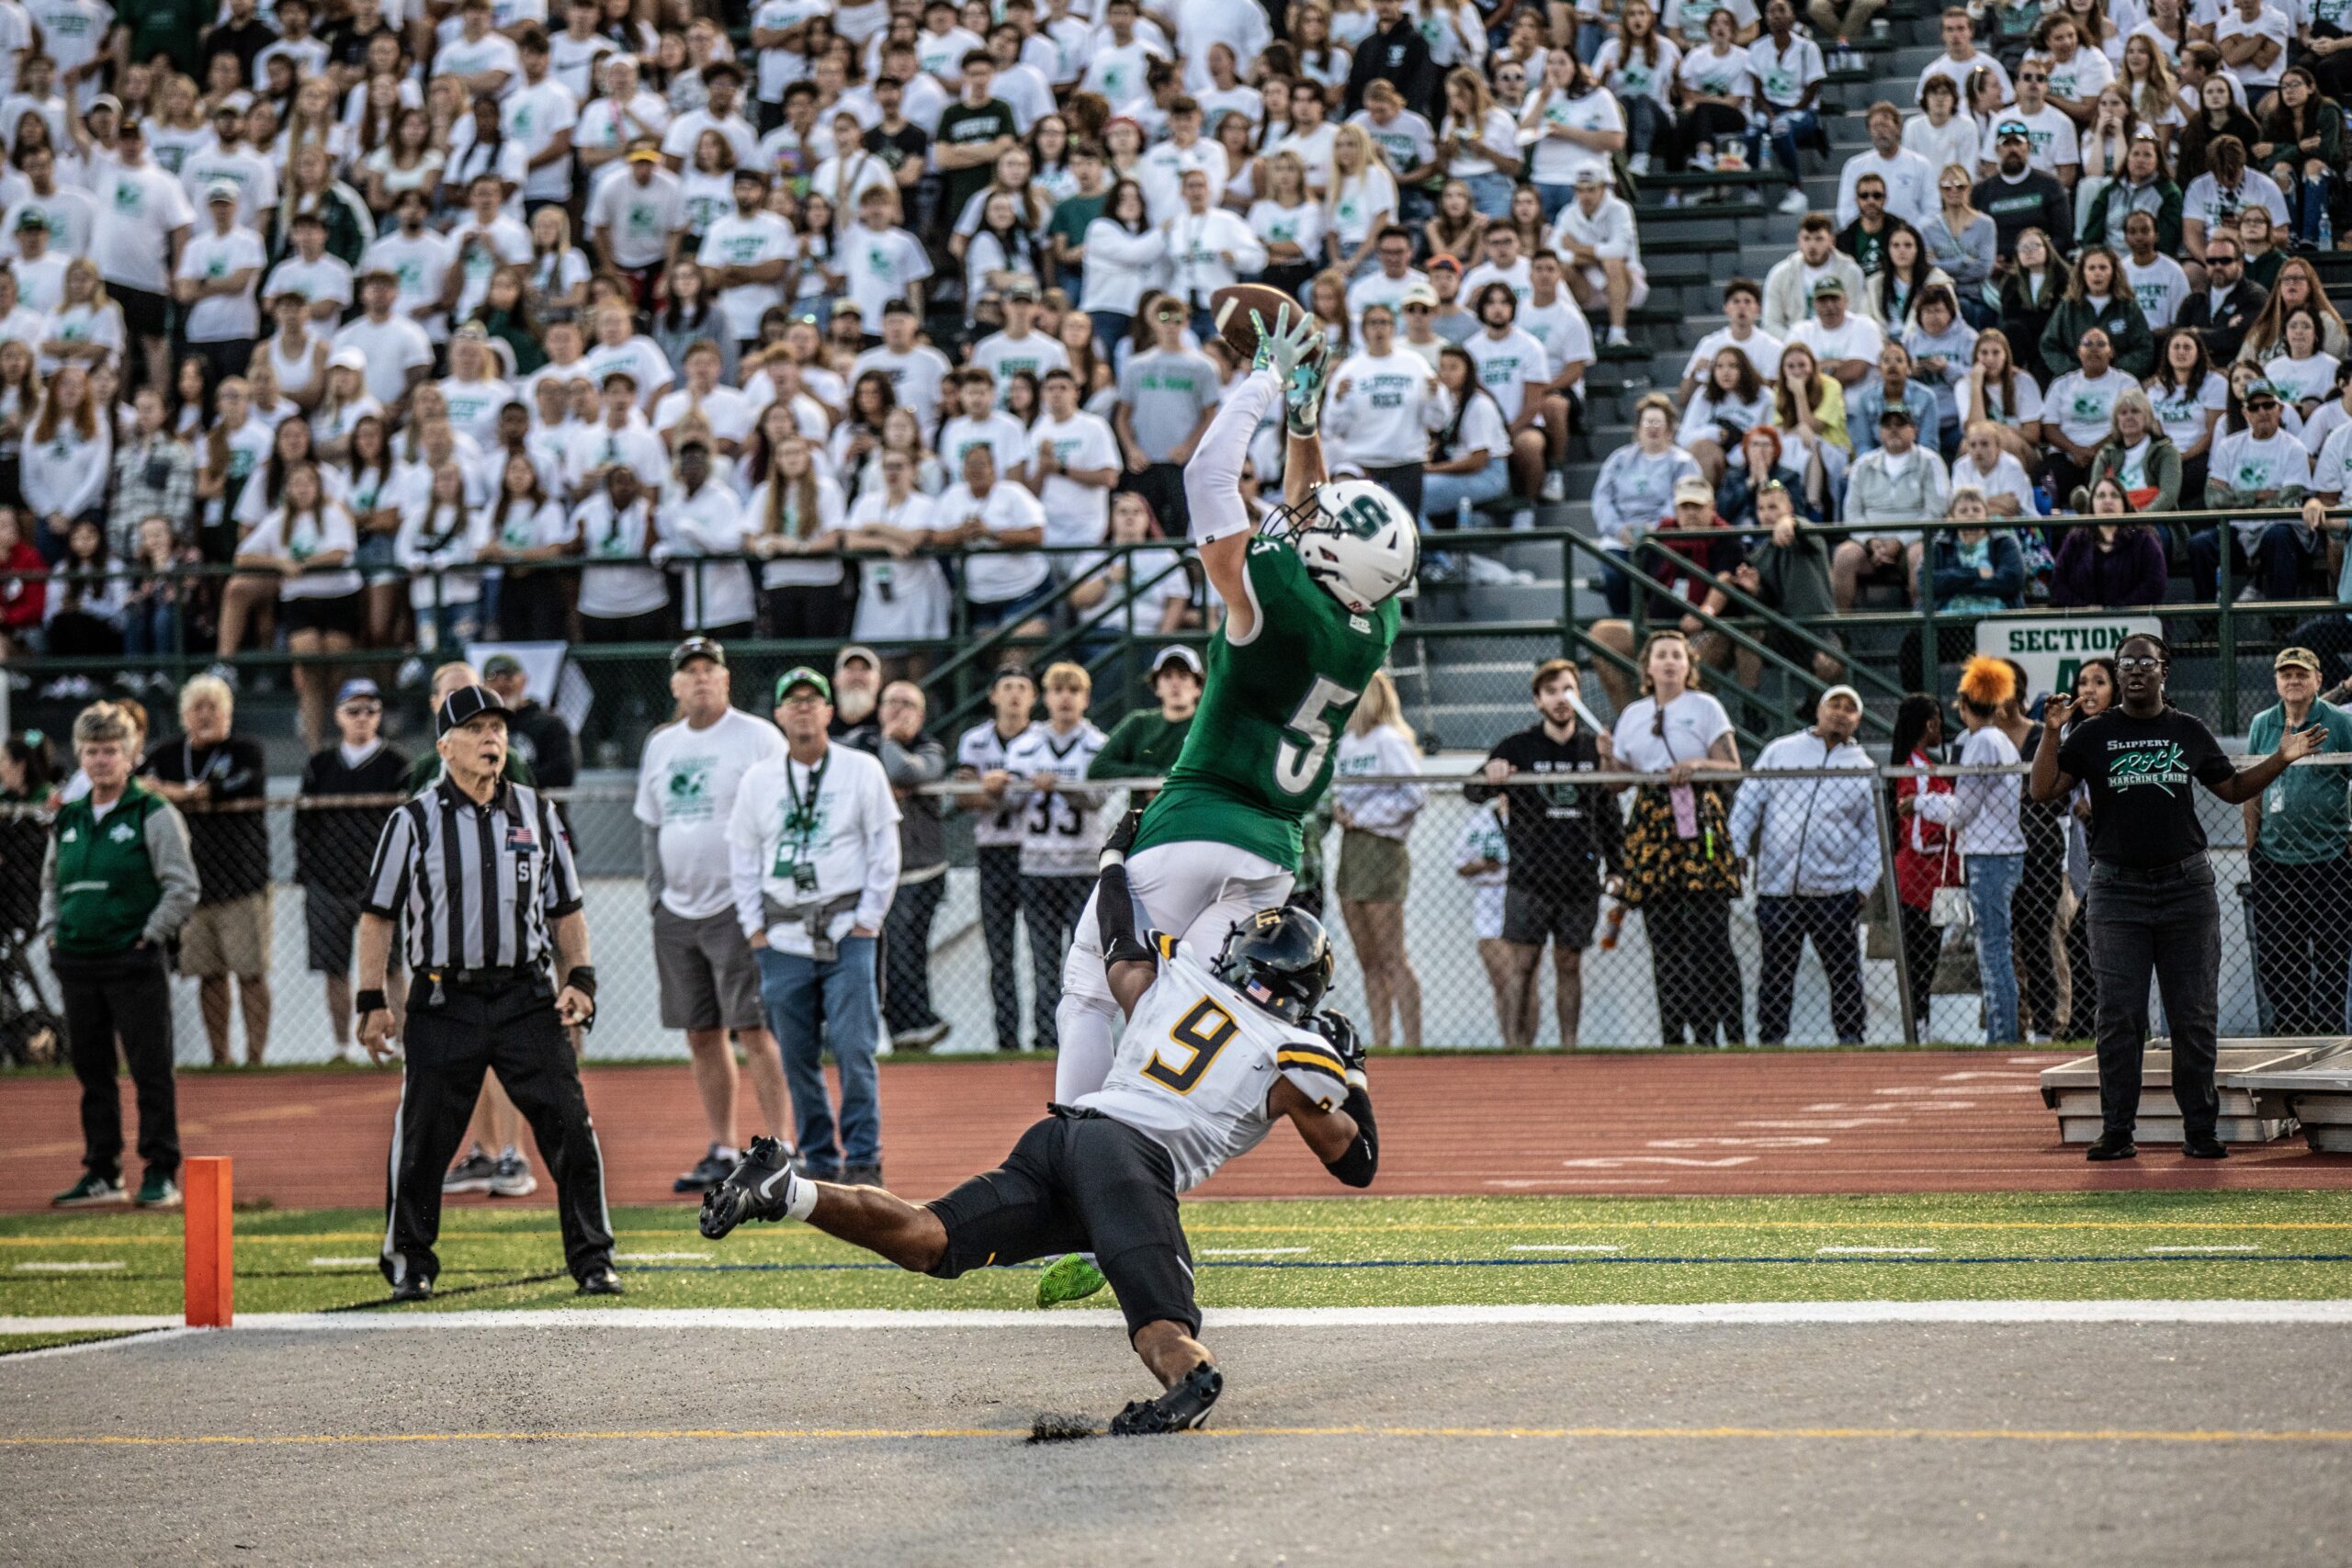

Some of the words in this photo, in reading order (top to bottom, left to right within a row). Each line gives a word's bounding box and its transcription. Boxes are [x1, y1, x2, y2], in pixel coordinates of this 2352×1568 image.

[1337, 494, 1392, 541] S
[2009, 627, 2129, 652] SECTION
[1273, 674, 1360, 795] 5
[2107, 739, 2170, 751] SLIPPERY
[2109, 773, 2158, 787] MARCHING
[2162, 773, 2187, 784] PRIDE
[516, 861, 531, 882] S
[1139, 995, 1239, 1096] 9
